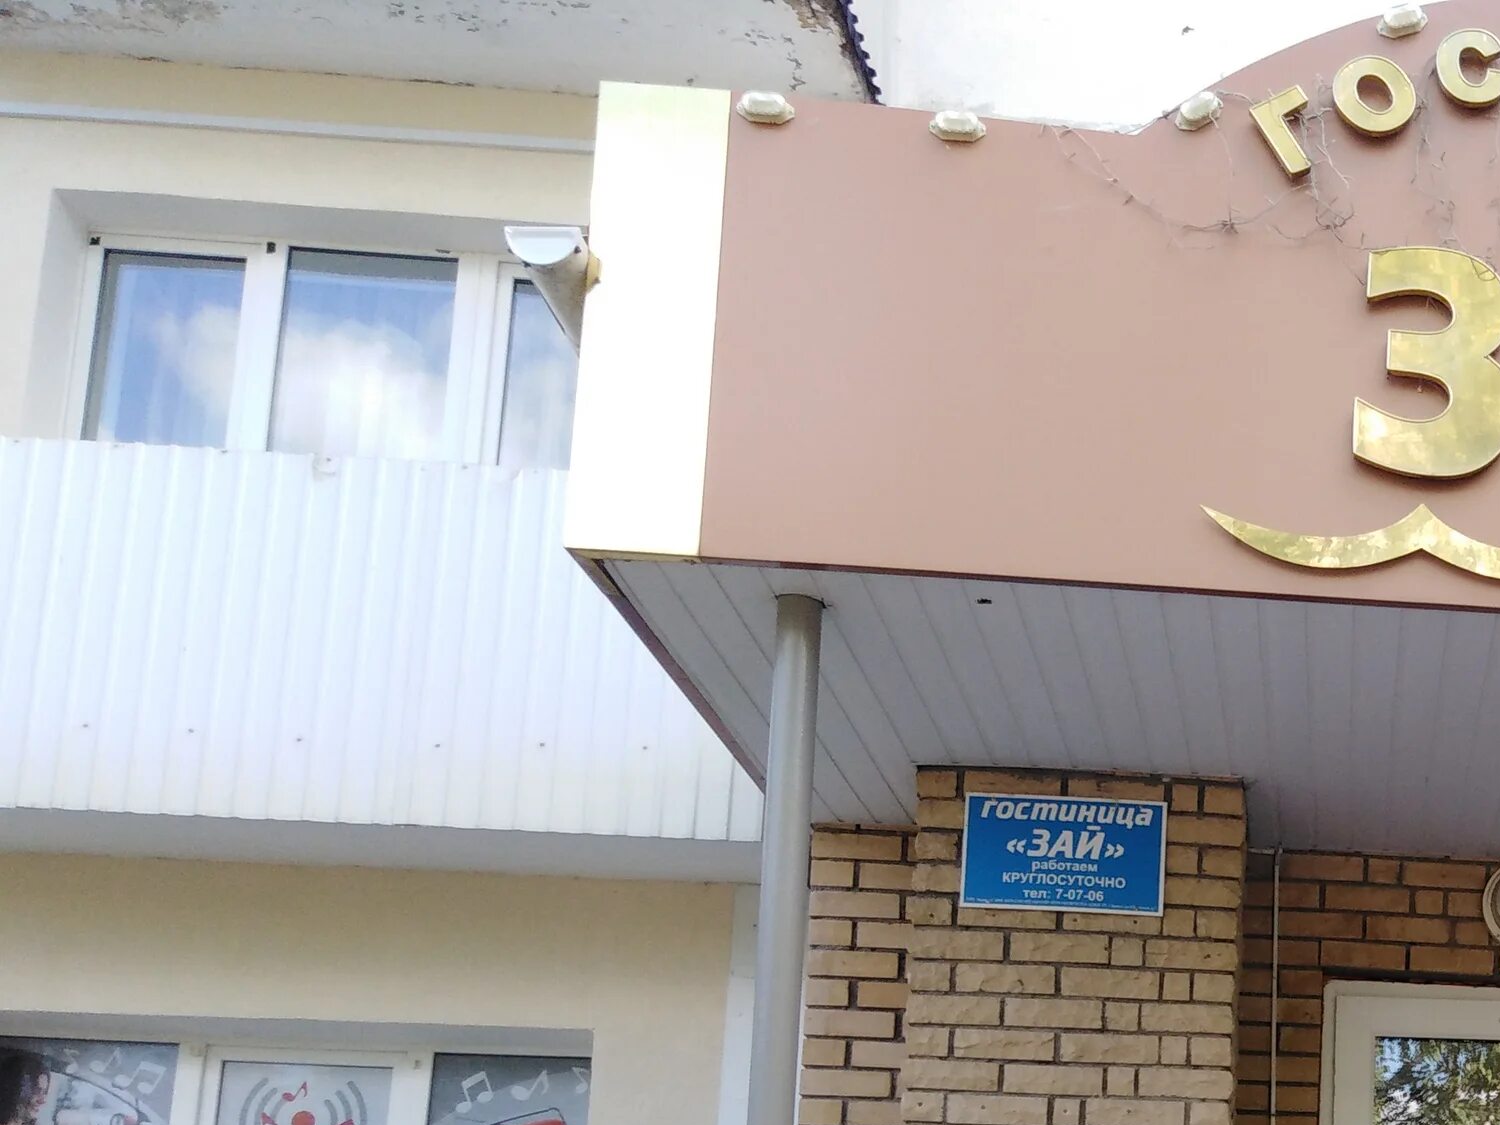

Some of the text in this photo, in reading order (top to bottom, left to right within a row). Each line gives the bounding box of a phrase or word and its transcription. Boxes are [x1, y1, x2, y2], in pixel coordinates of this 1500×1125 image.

[980, 798, 1154, 829] гостиница
[1006, 825, 1125, 860] «ЗАЙ»
[1031, 860, 1098, 873] работаем
[1002, 872, 1126, 889] КРУГЛОСУТОЧНО
[1023, 888, 1104, 902] тел: 7-07-06
